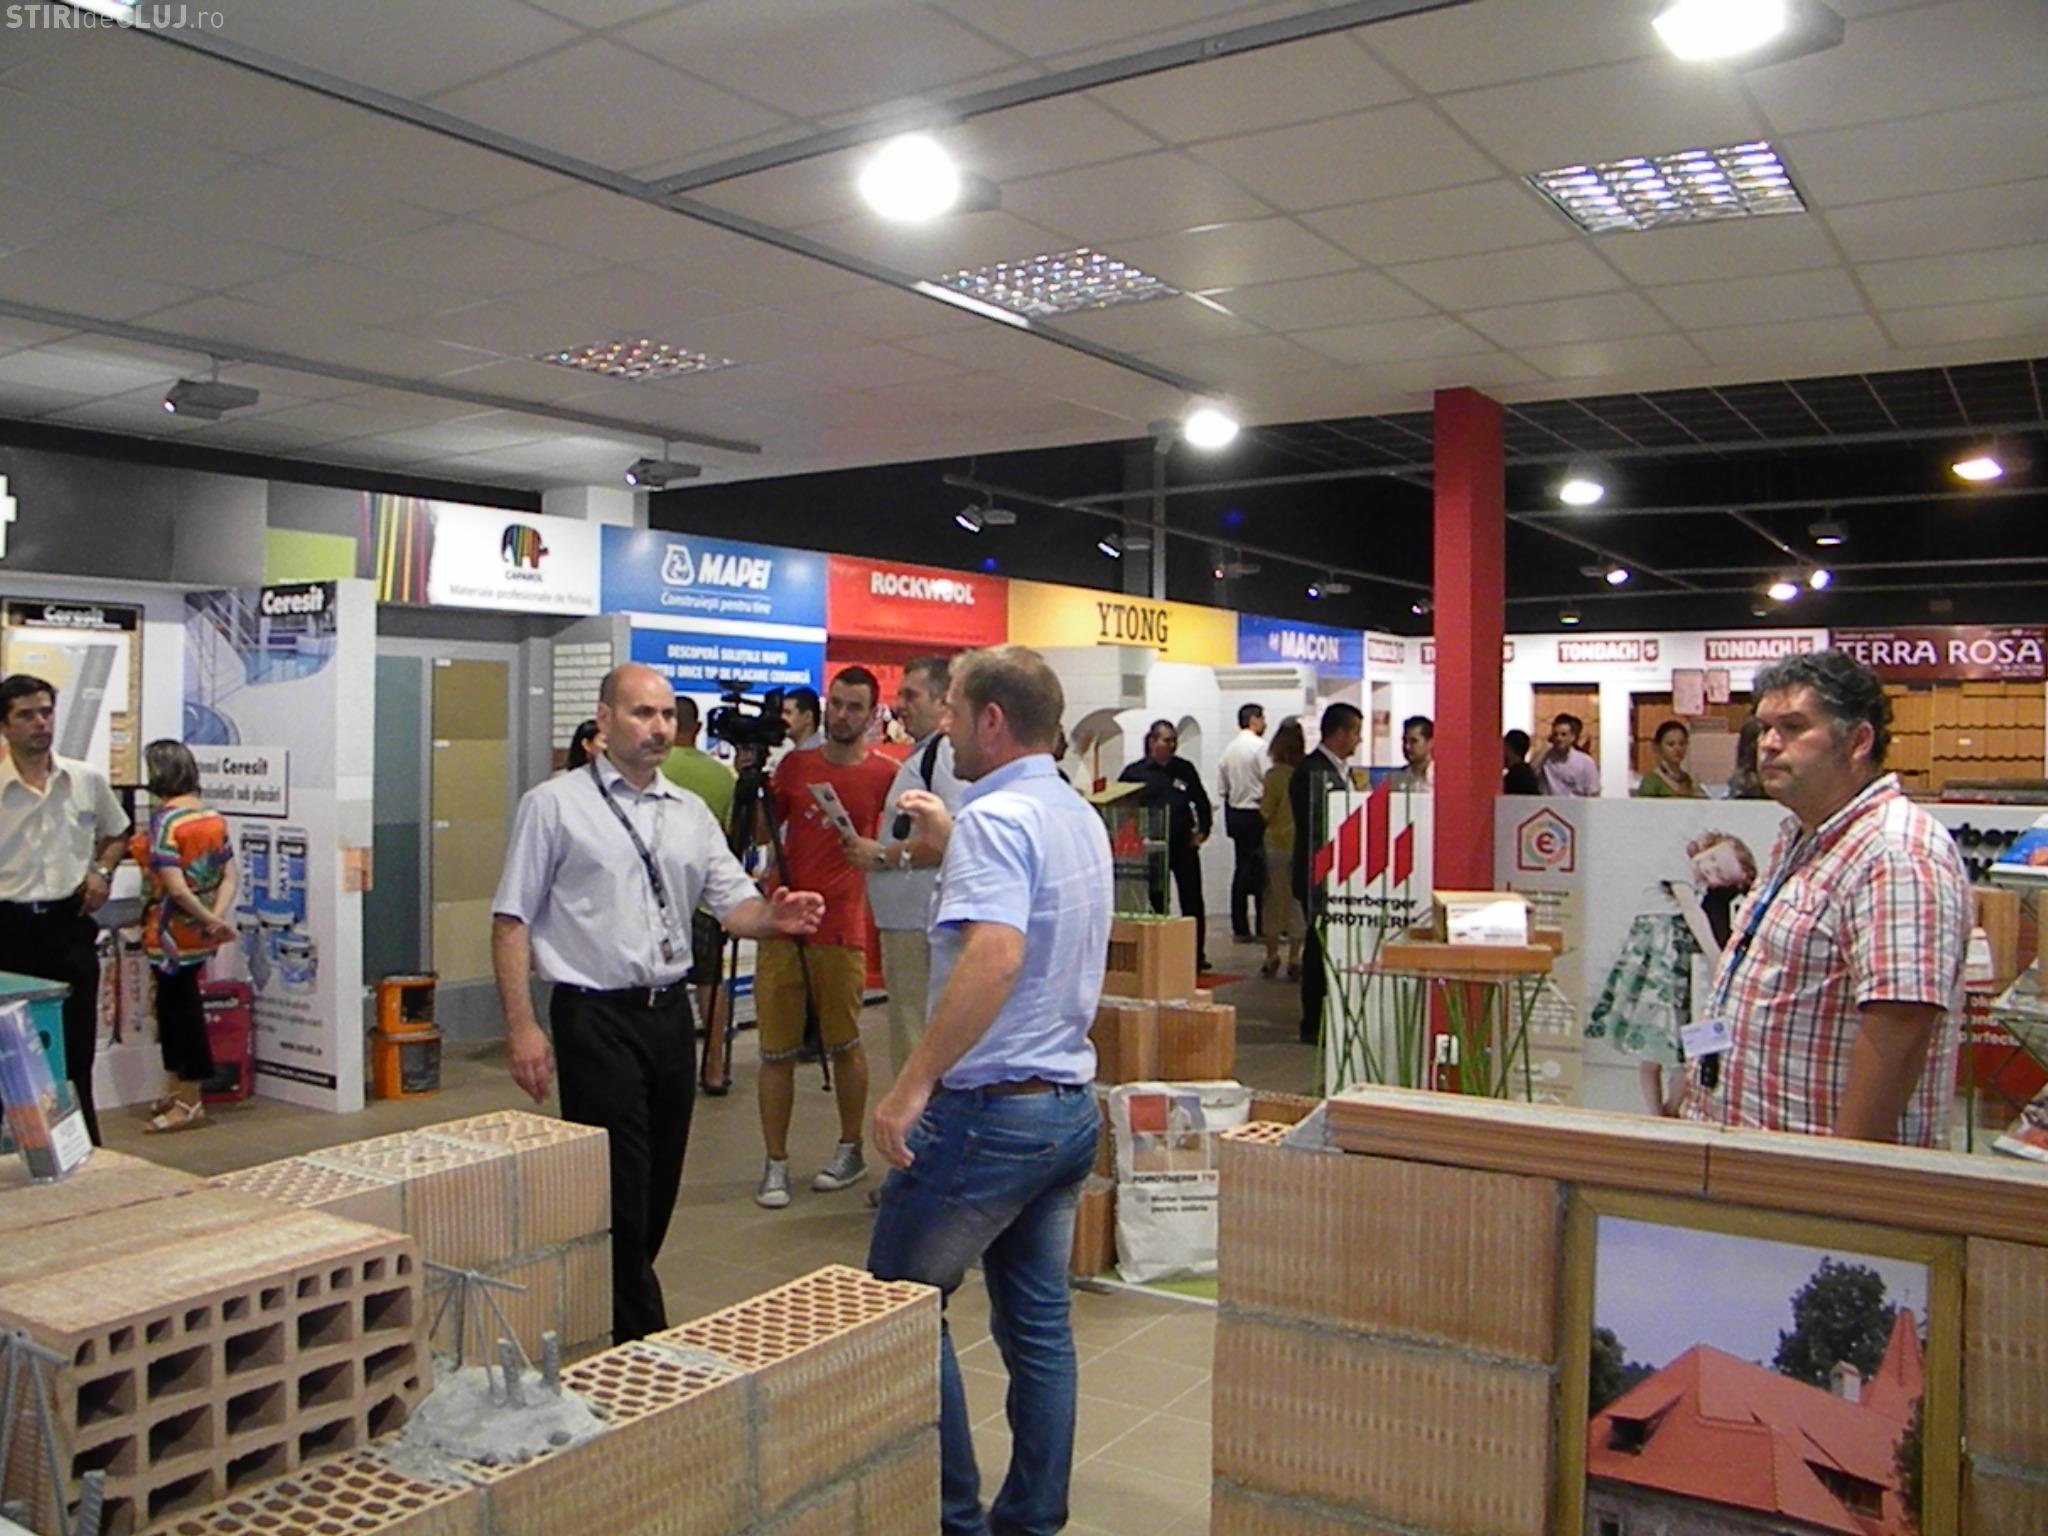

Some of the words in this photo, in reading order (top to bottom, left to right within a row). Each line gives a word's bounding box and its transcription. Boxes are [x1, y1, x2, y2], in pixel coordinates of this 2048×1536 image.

[698, 552, 772, 590] MAPEI
[262, 584, 324, 615] Ceresit
[1097, 602, 1168, 643] YTONG
[1281, 631, 1340, 662] MACON
[1561, 642, 1638, 661] TONDACH
[1708, 639, 1791, 660] TONDACH
[1835, 640, 1938, 665] TERRA
[1948, 638, 2042, 664] ROSA
[223, 757, 268, 775] Ceresit
